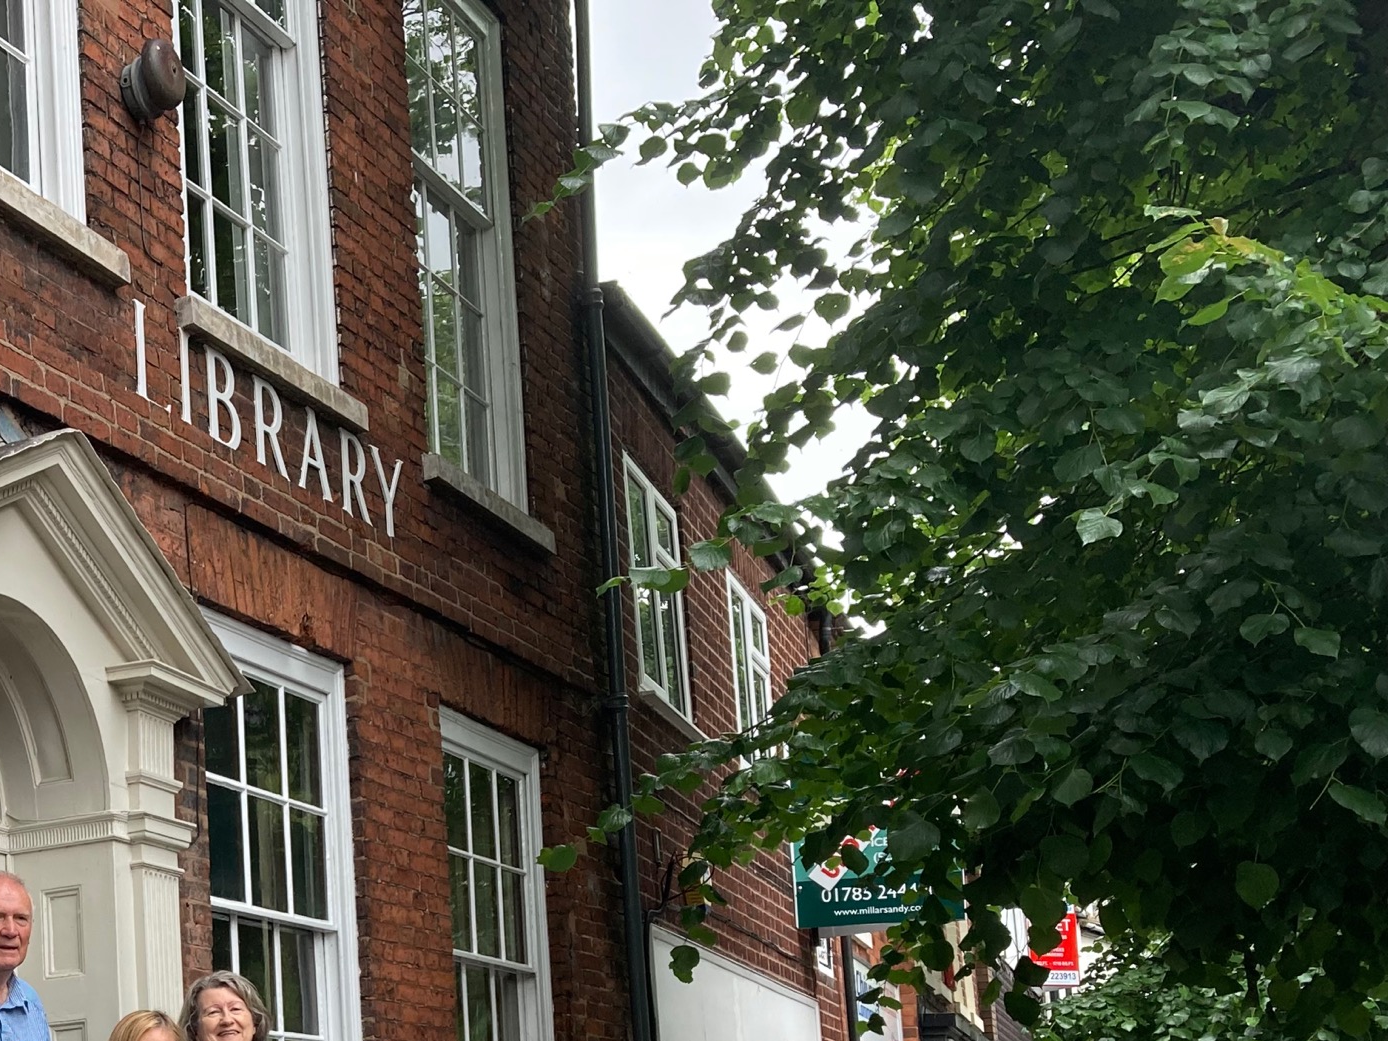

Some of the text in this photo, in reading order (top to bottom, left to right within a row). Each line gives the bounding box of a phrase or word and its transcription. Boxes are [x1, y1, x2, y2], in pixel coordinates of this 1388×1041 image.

[132, 299, 404, 537] LIBRARY
[821, 886, 872, 903] 01785
[834, 904, 922, 916] www.millarsandy.co
